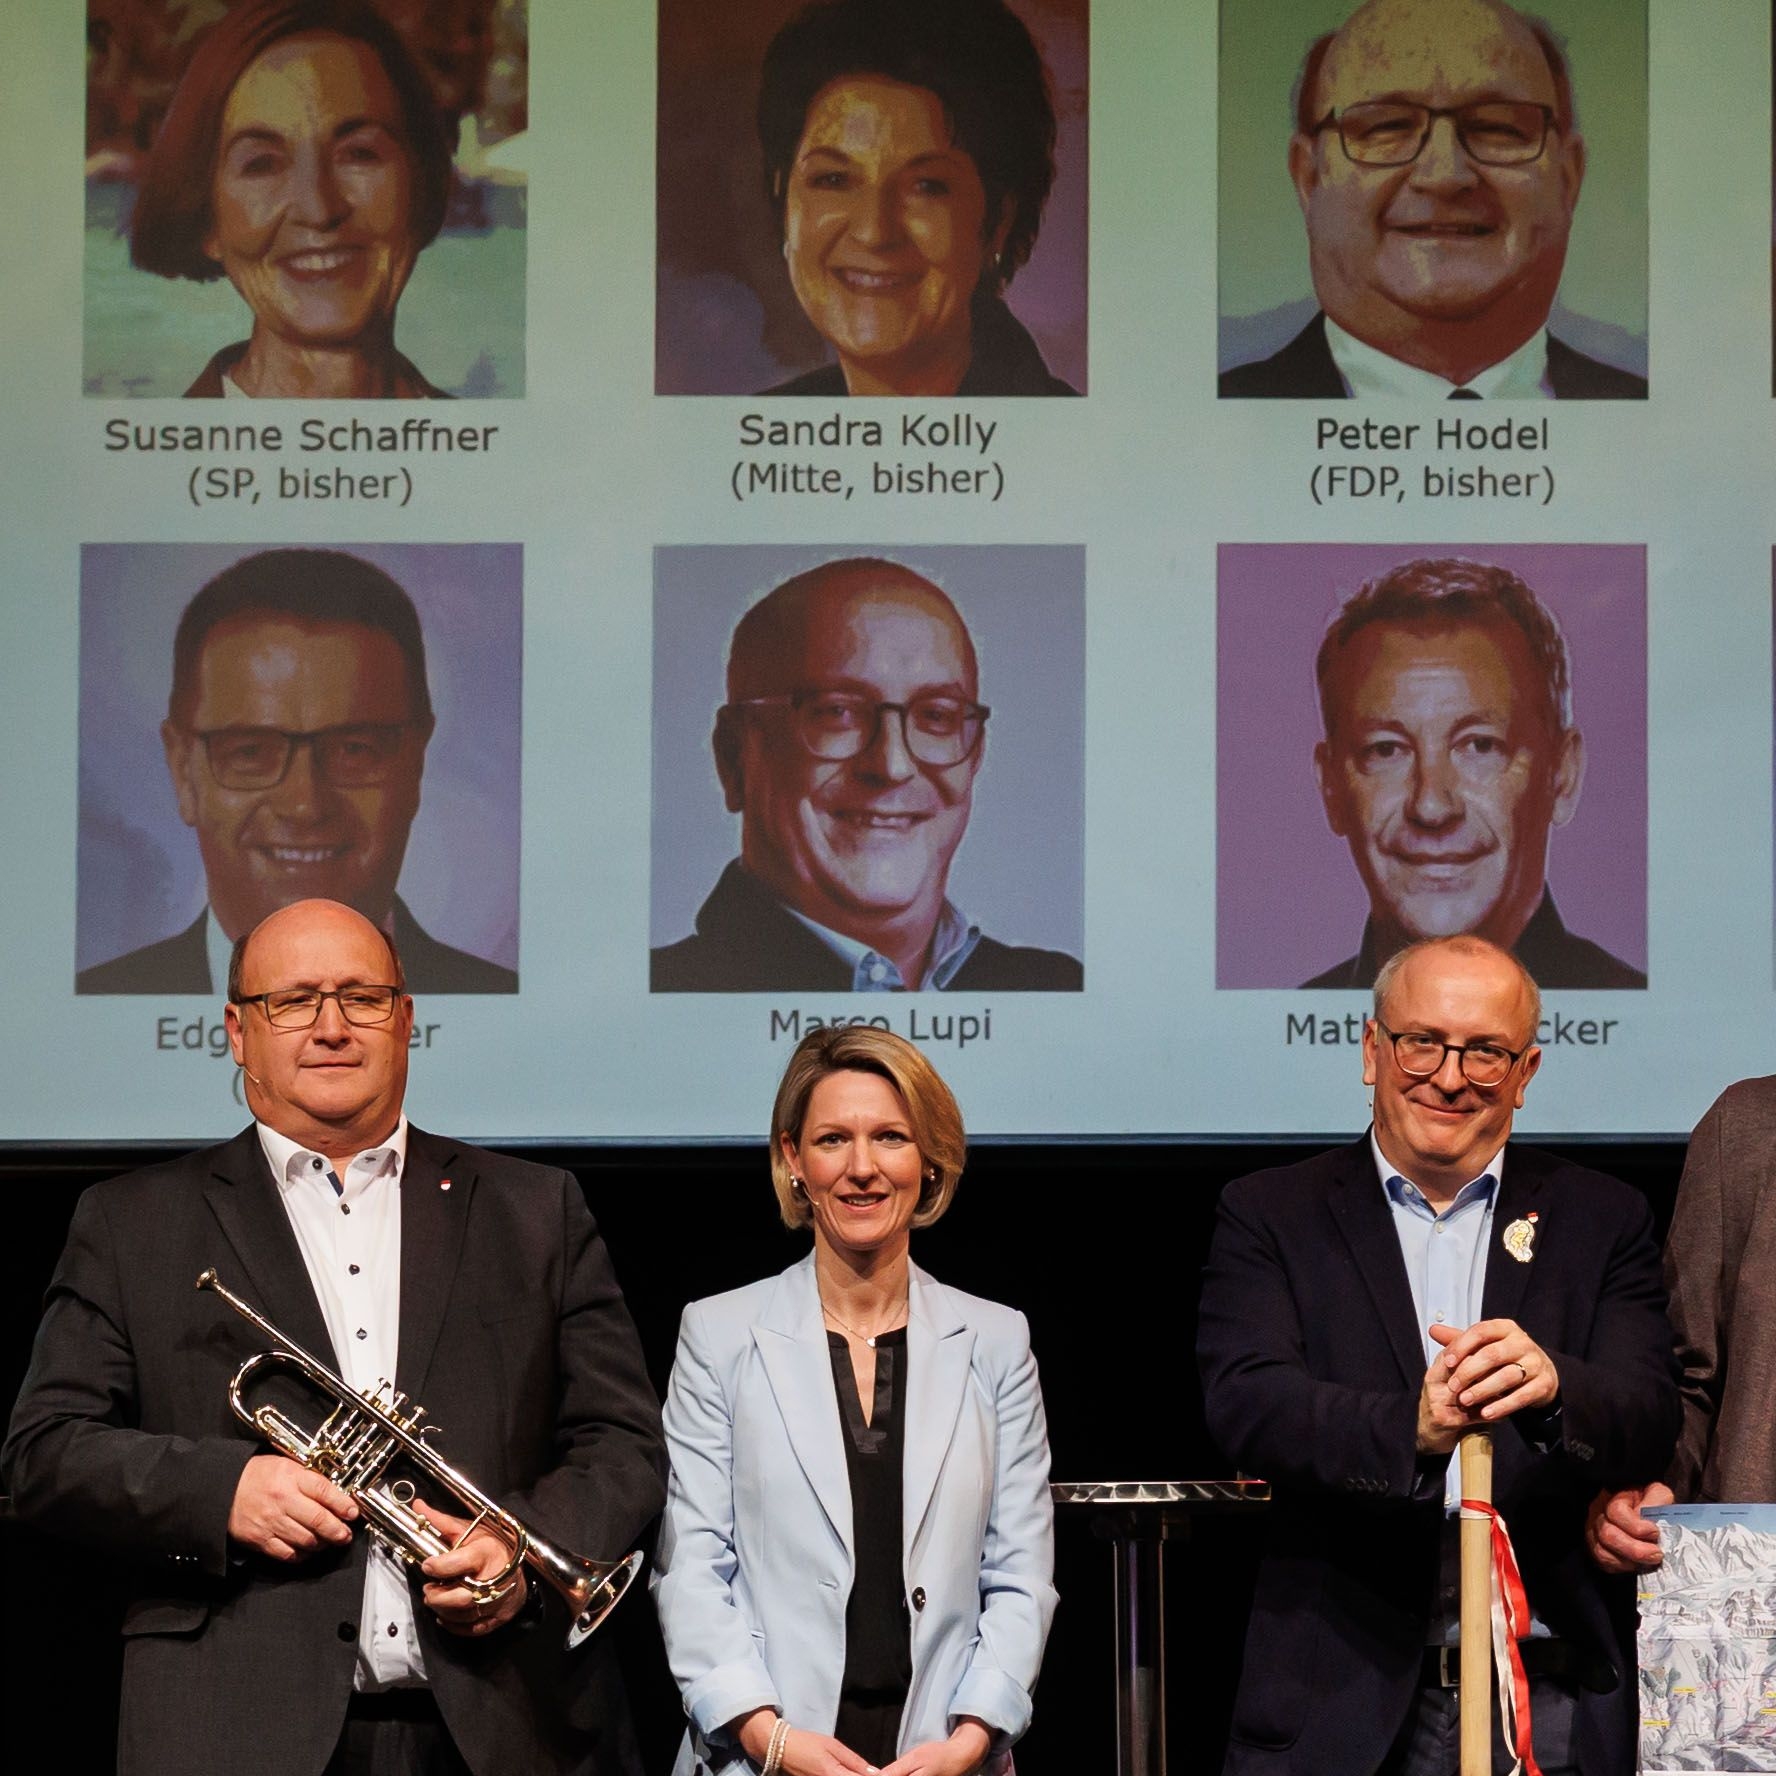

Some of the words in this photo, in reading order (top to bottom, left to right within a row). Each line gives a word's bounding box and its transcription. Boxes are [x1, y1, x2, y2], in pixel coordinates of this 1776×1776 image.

[105, 418, 282, 452] Susanne
[300, 418, 498, 452] Schaffner
[740, 413, 882, 447] Sandra
[902, 413, 997, 455] Kolly
[1317, 417, 1420, 450] Peter
[1437, 417, 1548, 451] Hodel
[188, 466, 260, 507] (SP,
[279, 466, 413, 507] bisher)
[731, 461, 854, 502] (Mitte,
[873, 461, 1004, 503] bisher)
[1310, 464, 1405, 506] (FDP,
[1423, 465, 1555, 506] bisher)
[156, 1016, 228, 1058] Edg
[910, 1008, 991, 1048] Lupi
